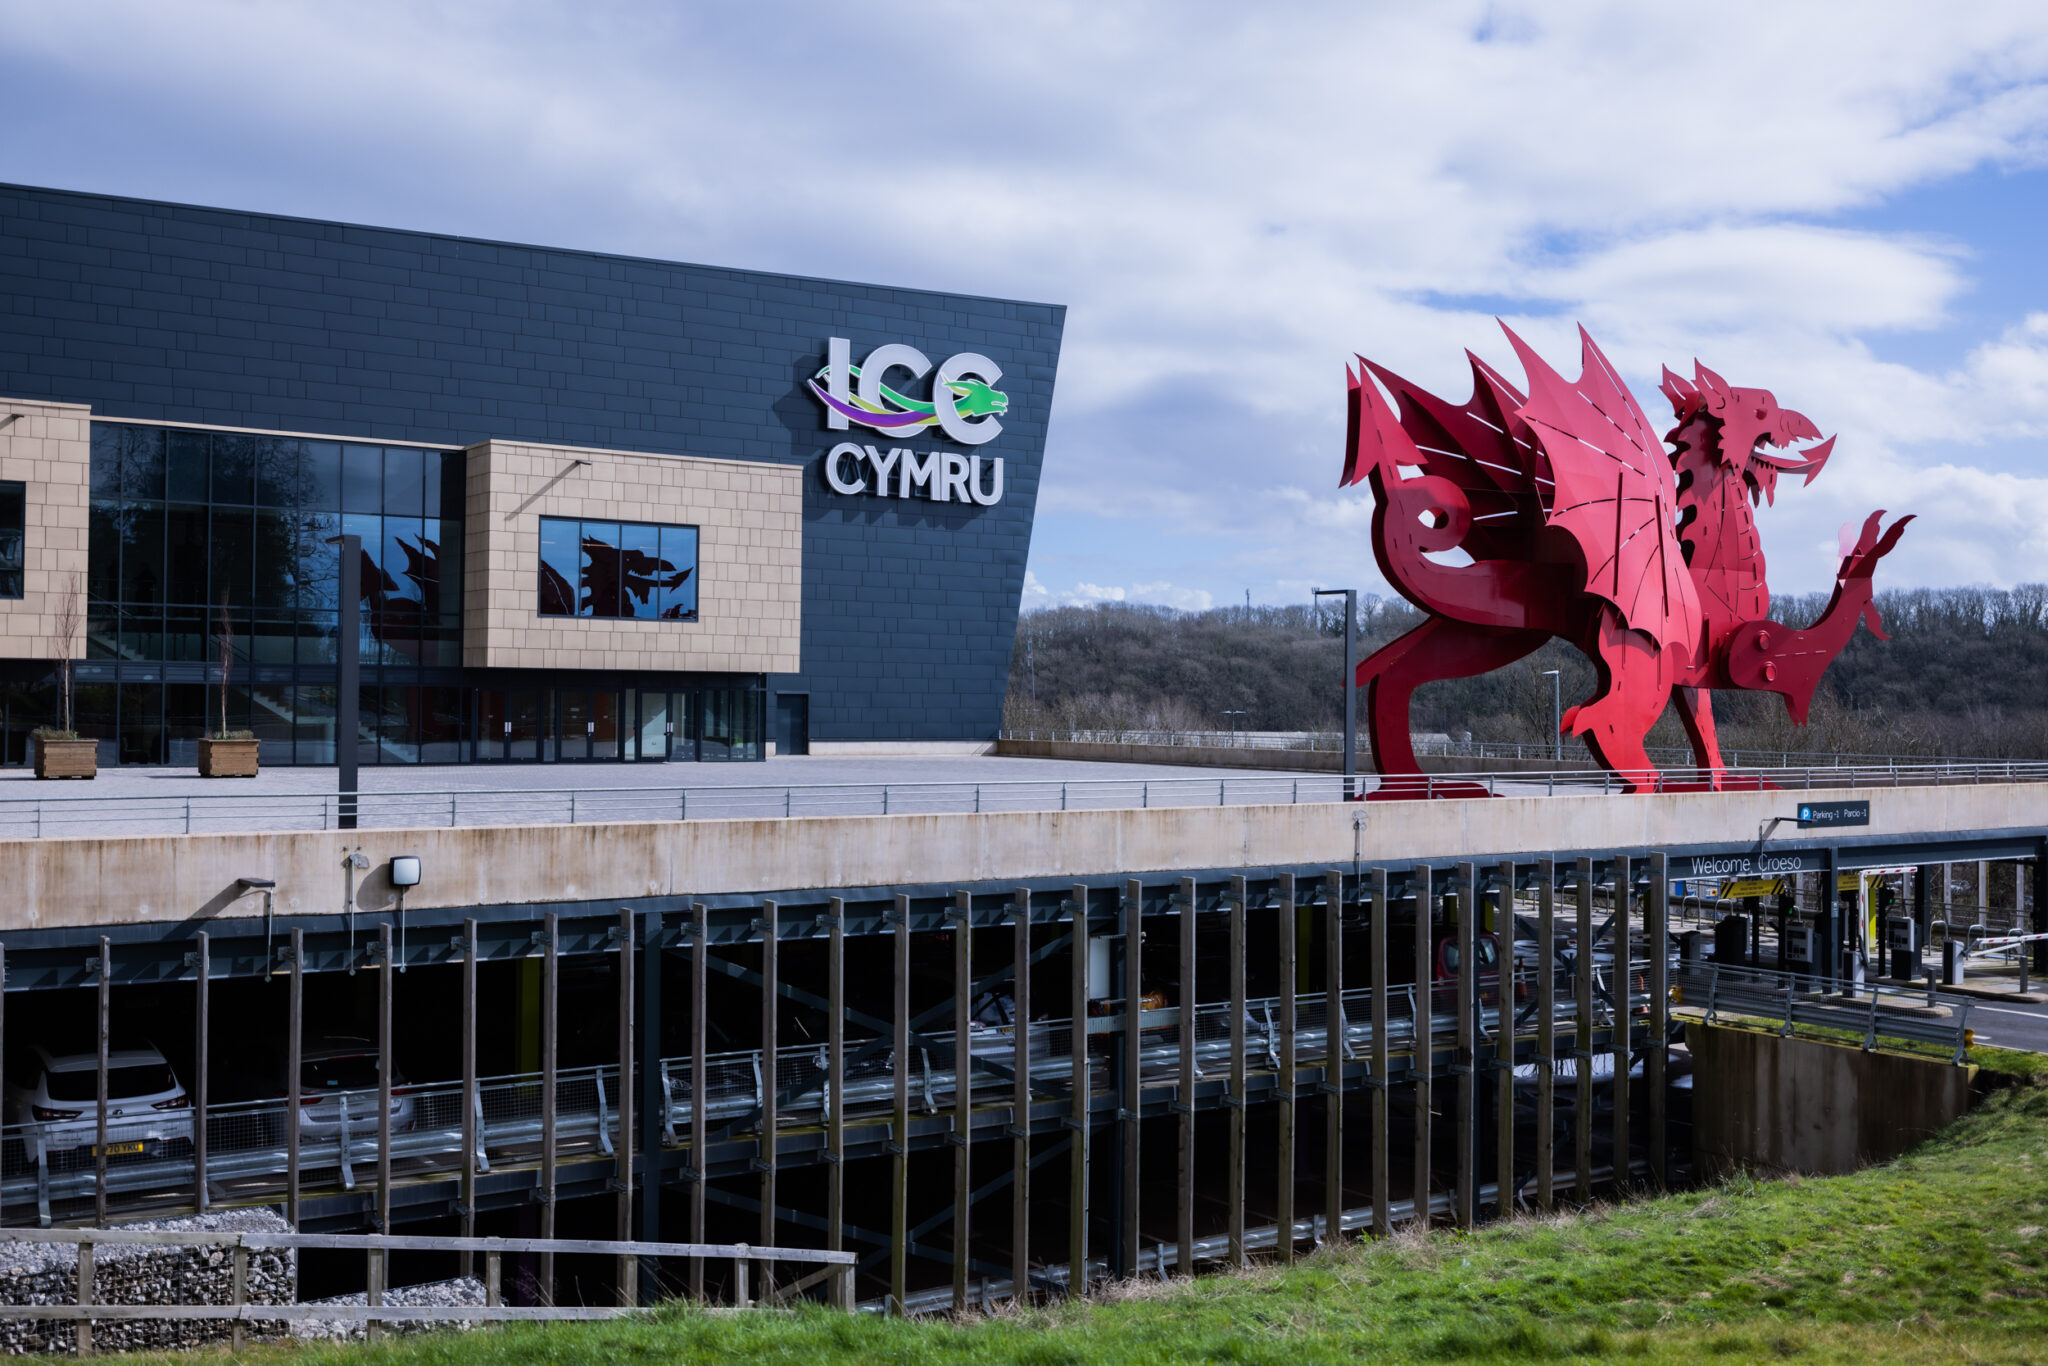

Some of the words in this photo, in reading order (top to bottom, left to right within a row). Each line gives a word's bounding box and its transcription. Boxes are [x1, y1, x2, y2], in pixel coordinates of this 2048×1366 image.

[827, 337, 1004, 445] ICC
[825, 442, 1004, 506] CYMRU
[1812, 810, 1833, 821] Parking
[1843, 808, 1861, 818] Parcio
[1691, 856, 1751, 875] Welcome
[1758, 853, 1802, 872] Croeso
